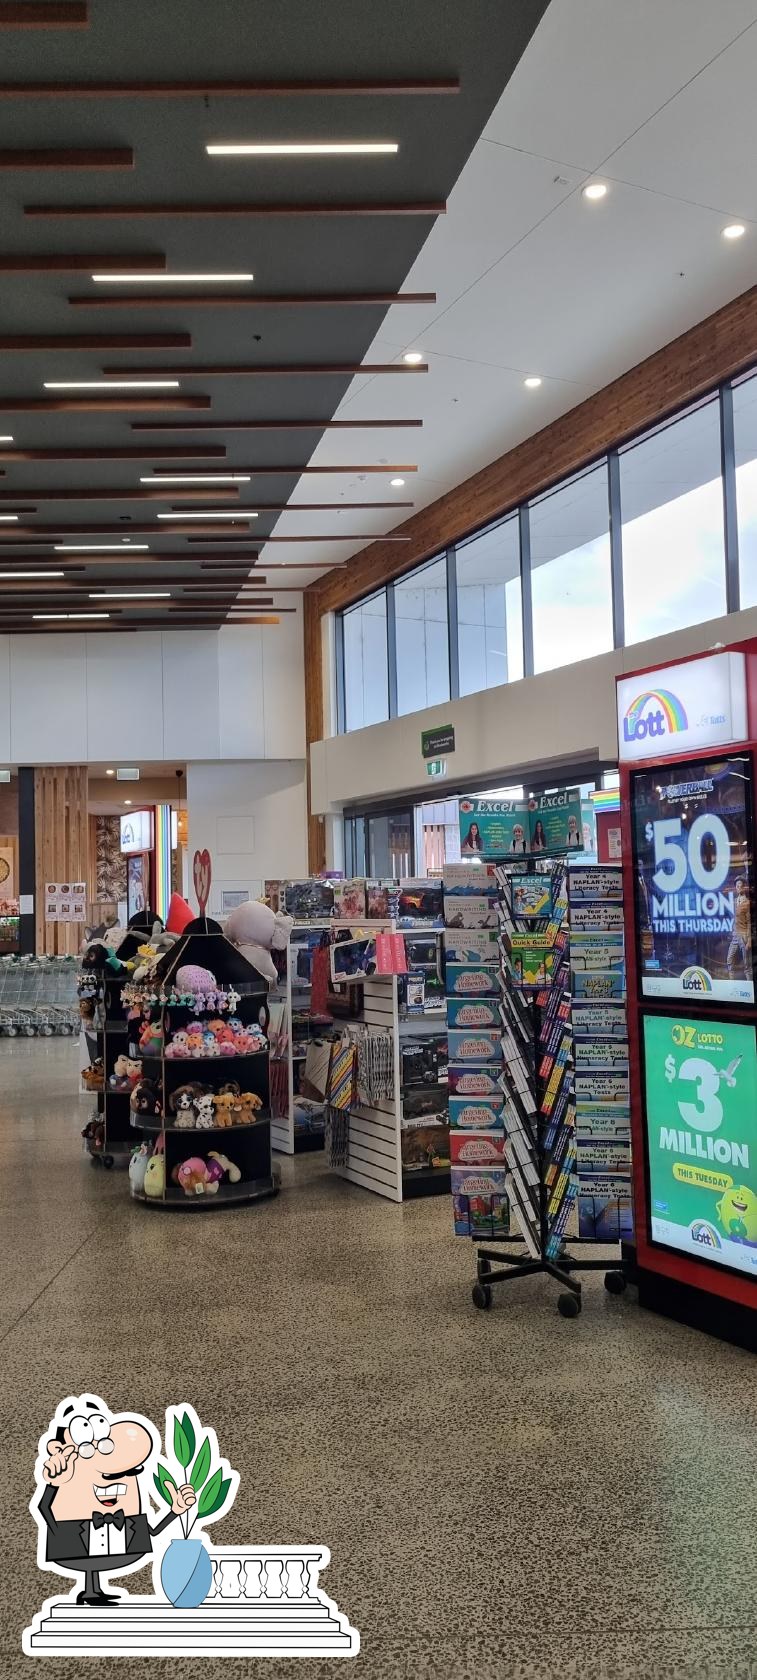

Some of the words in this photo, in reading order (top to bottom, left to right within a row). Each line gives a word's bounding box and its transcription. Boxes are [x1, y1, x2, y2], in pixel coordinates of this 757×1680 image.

[624, 710, 665, 742] Lott
[660, 778, 714, 800] POWERBALL
[477, 801, 514, 812] Excel
[540, 792, 568, 809] Excel
[652, 890, 735, 919] MILLION
[653, 919, 676, 933] THIS
[678, 918, 734, 933] THURSDAY
[683, 979, 702, 990] Lott
[671, 1024, 697, 1049] OZ
[697, 1033, 723, 1045] LOTTO
[659, 1126, 750, 1169] MILLION
[677, 1167, 694, 1180] THIS
[694, 1171, 728, 1189] TUESDAY
[691, 1229, 712, 1246] Lott
